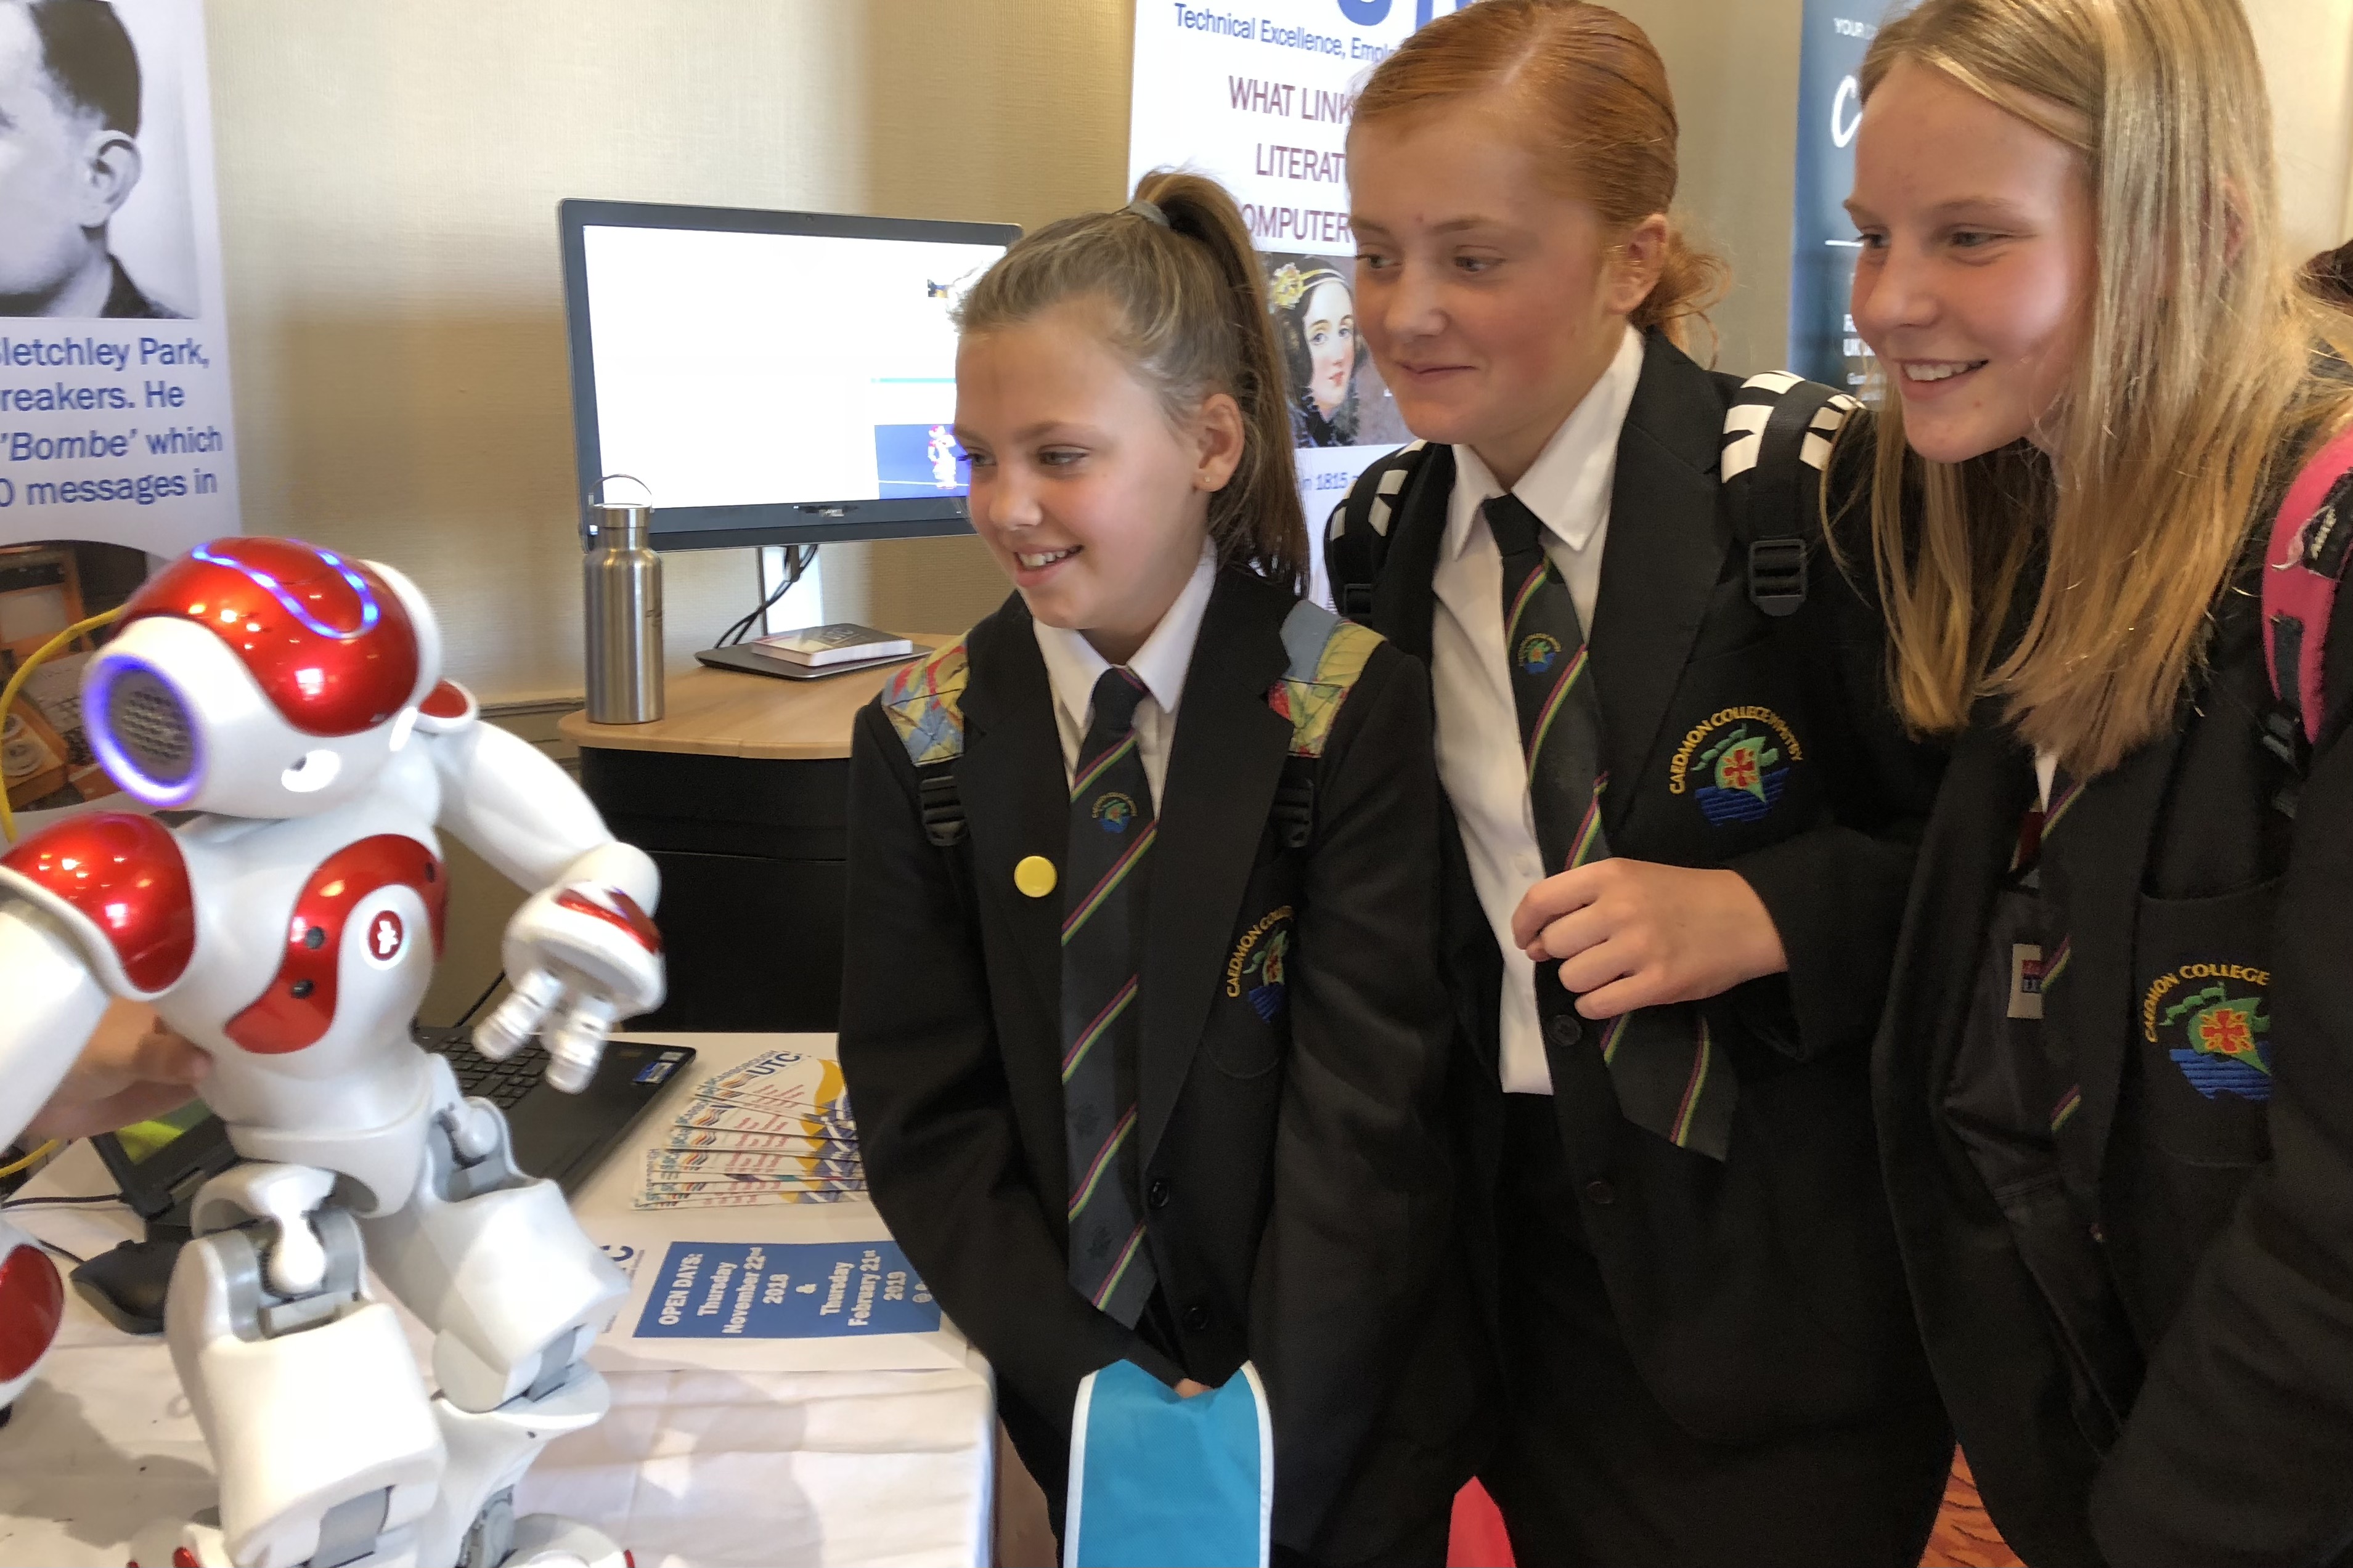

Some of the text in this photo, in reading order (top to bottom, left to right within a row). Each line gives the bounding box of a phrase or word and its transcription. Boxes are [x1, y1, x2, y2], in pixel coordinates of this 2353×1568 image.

[1174, 2, 1255, 39] Technical
[1260, 19, 1346, 60] Excellence,
[1229, 75, 1295, 117] WHAT
[1255, 143, 1345, 184] LITERAT
[0, 337, 210, 371] letchley Park,
[144, 380, 184, 408] He
[146, 426, 223, 455] which
[26, 473, 187, 505] messages
[193, 468, 218, 494] in
[1316, 471, 1348, 490] 1815
[2179, 964, 2272, 986] COLLEGE
[746, 1053, 801, 1075] UTC
[658, 1290, 690, 1325] OPEN
[696, 1262, 738, 1316] Thursday
[721, 1272, 761, 1334] November
[819, 1262, 855, 1316] Thursday
[847, 1273, 882, 1326] February
